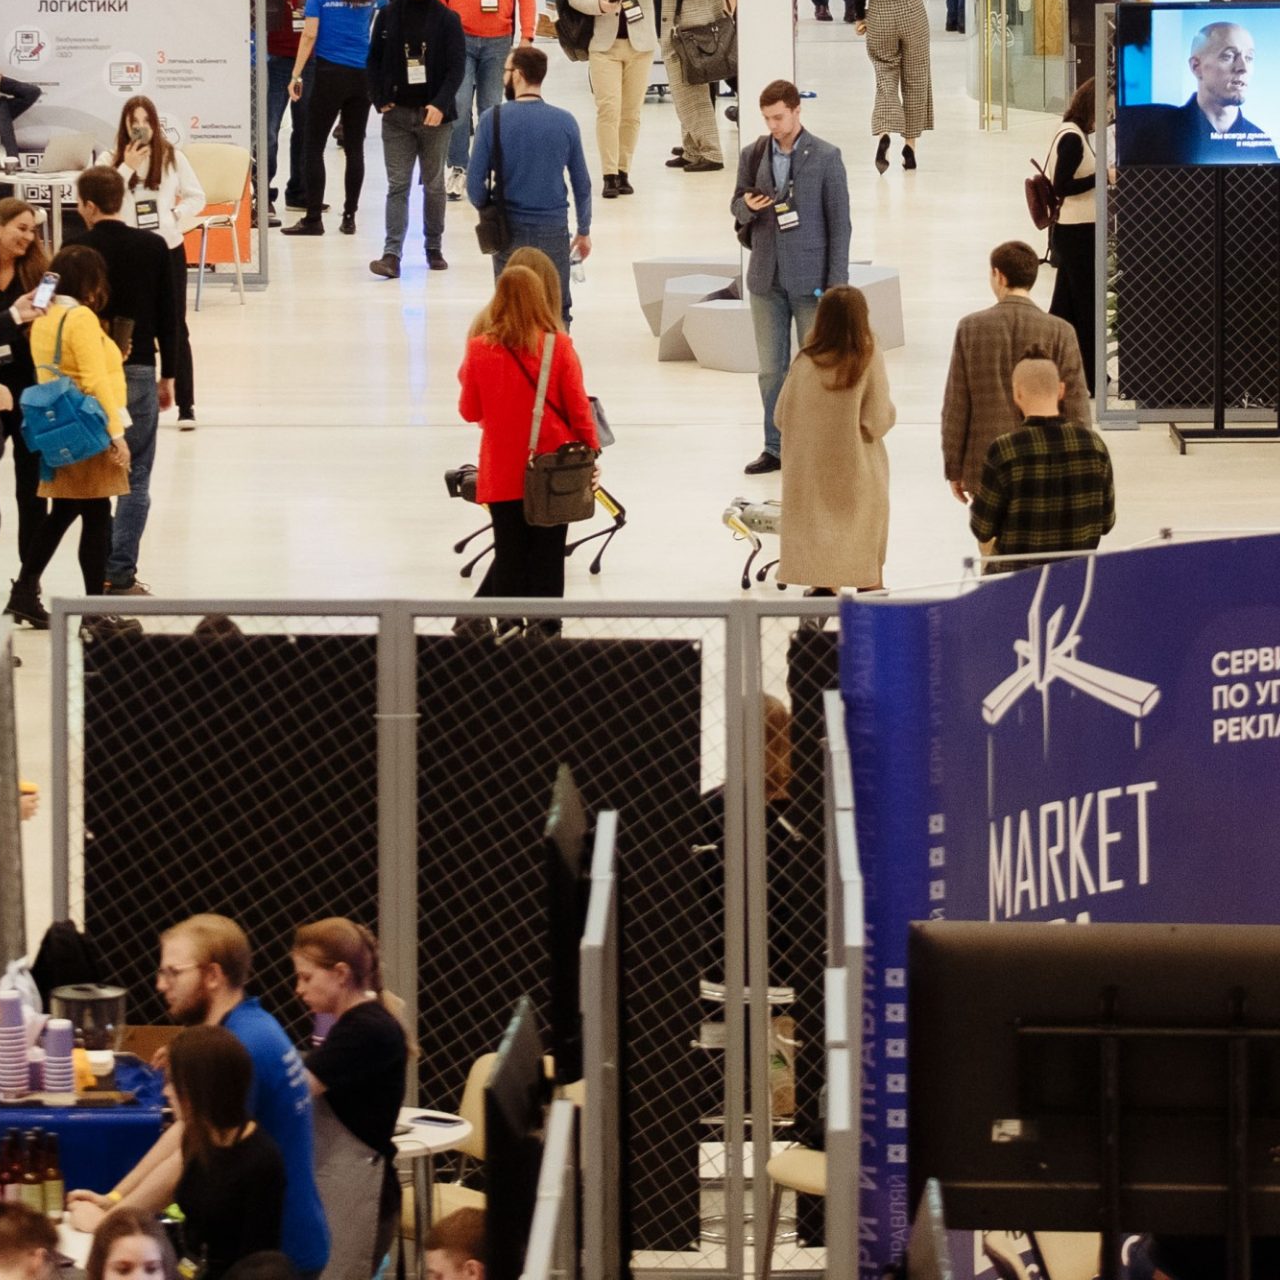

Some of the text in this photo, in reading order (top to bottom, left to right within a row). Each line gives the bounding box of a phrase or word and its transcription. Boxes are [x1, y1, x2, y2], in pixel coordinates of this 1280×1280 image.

[38, 0, 129, 13] ЛОГИСТИКИ
[157, 50, 165, 63] 3
[191, 116, 199, 129] 2
[1212, 683, 1250, 711] ПО
[989, 781, 1158, 923] MARKET
